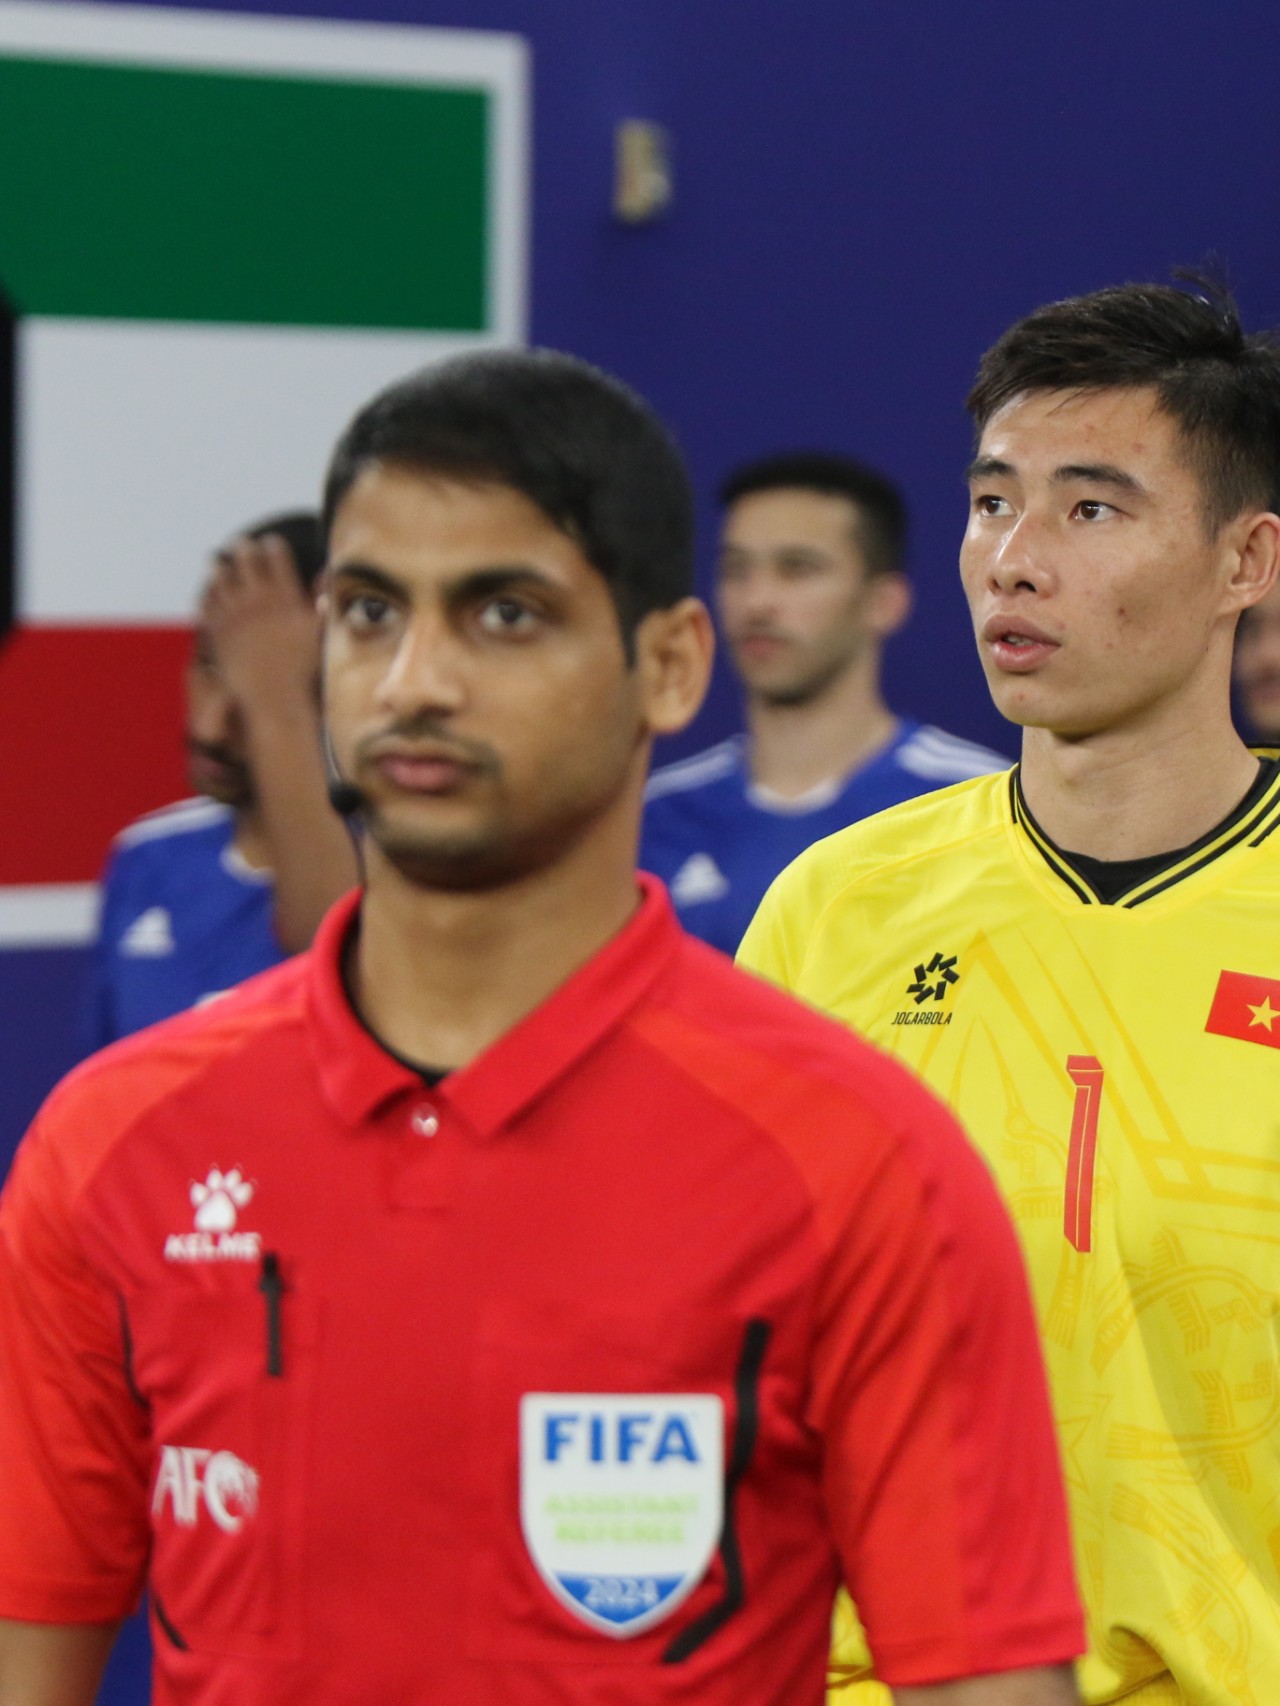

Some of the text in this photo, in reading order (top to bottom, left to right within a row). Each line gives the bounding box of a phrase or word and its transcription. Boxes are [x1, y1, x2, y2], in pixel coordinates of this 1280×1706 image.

[891, 1011, 953, 1026] JOGARBOLA
[1064, 1054, 1105, 1253] 1
[163, 1231, 262, 1263] KELME
[544, 1412, 702, 1465] FIFA
[151, 1444, 260, 1534] AFC
